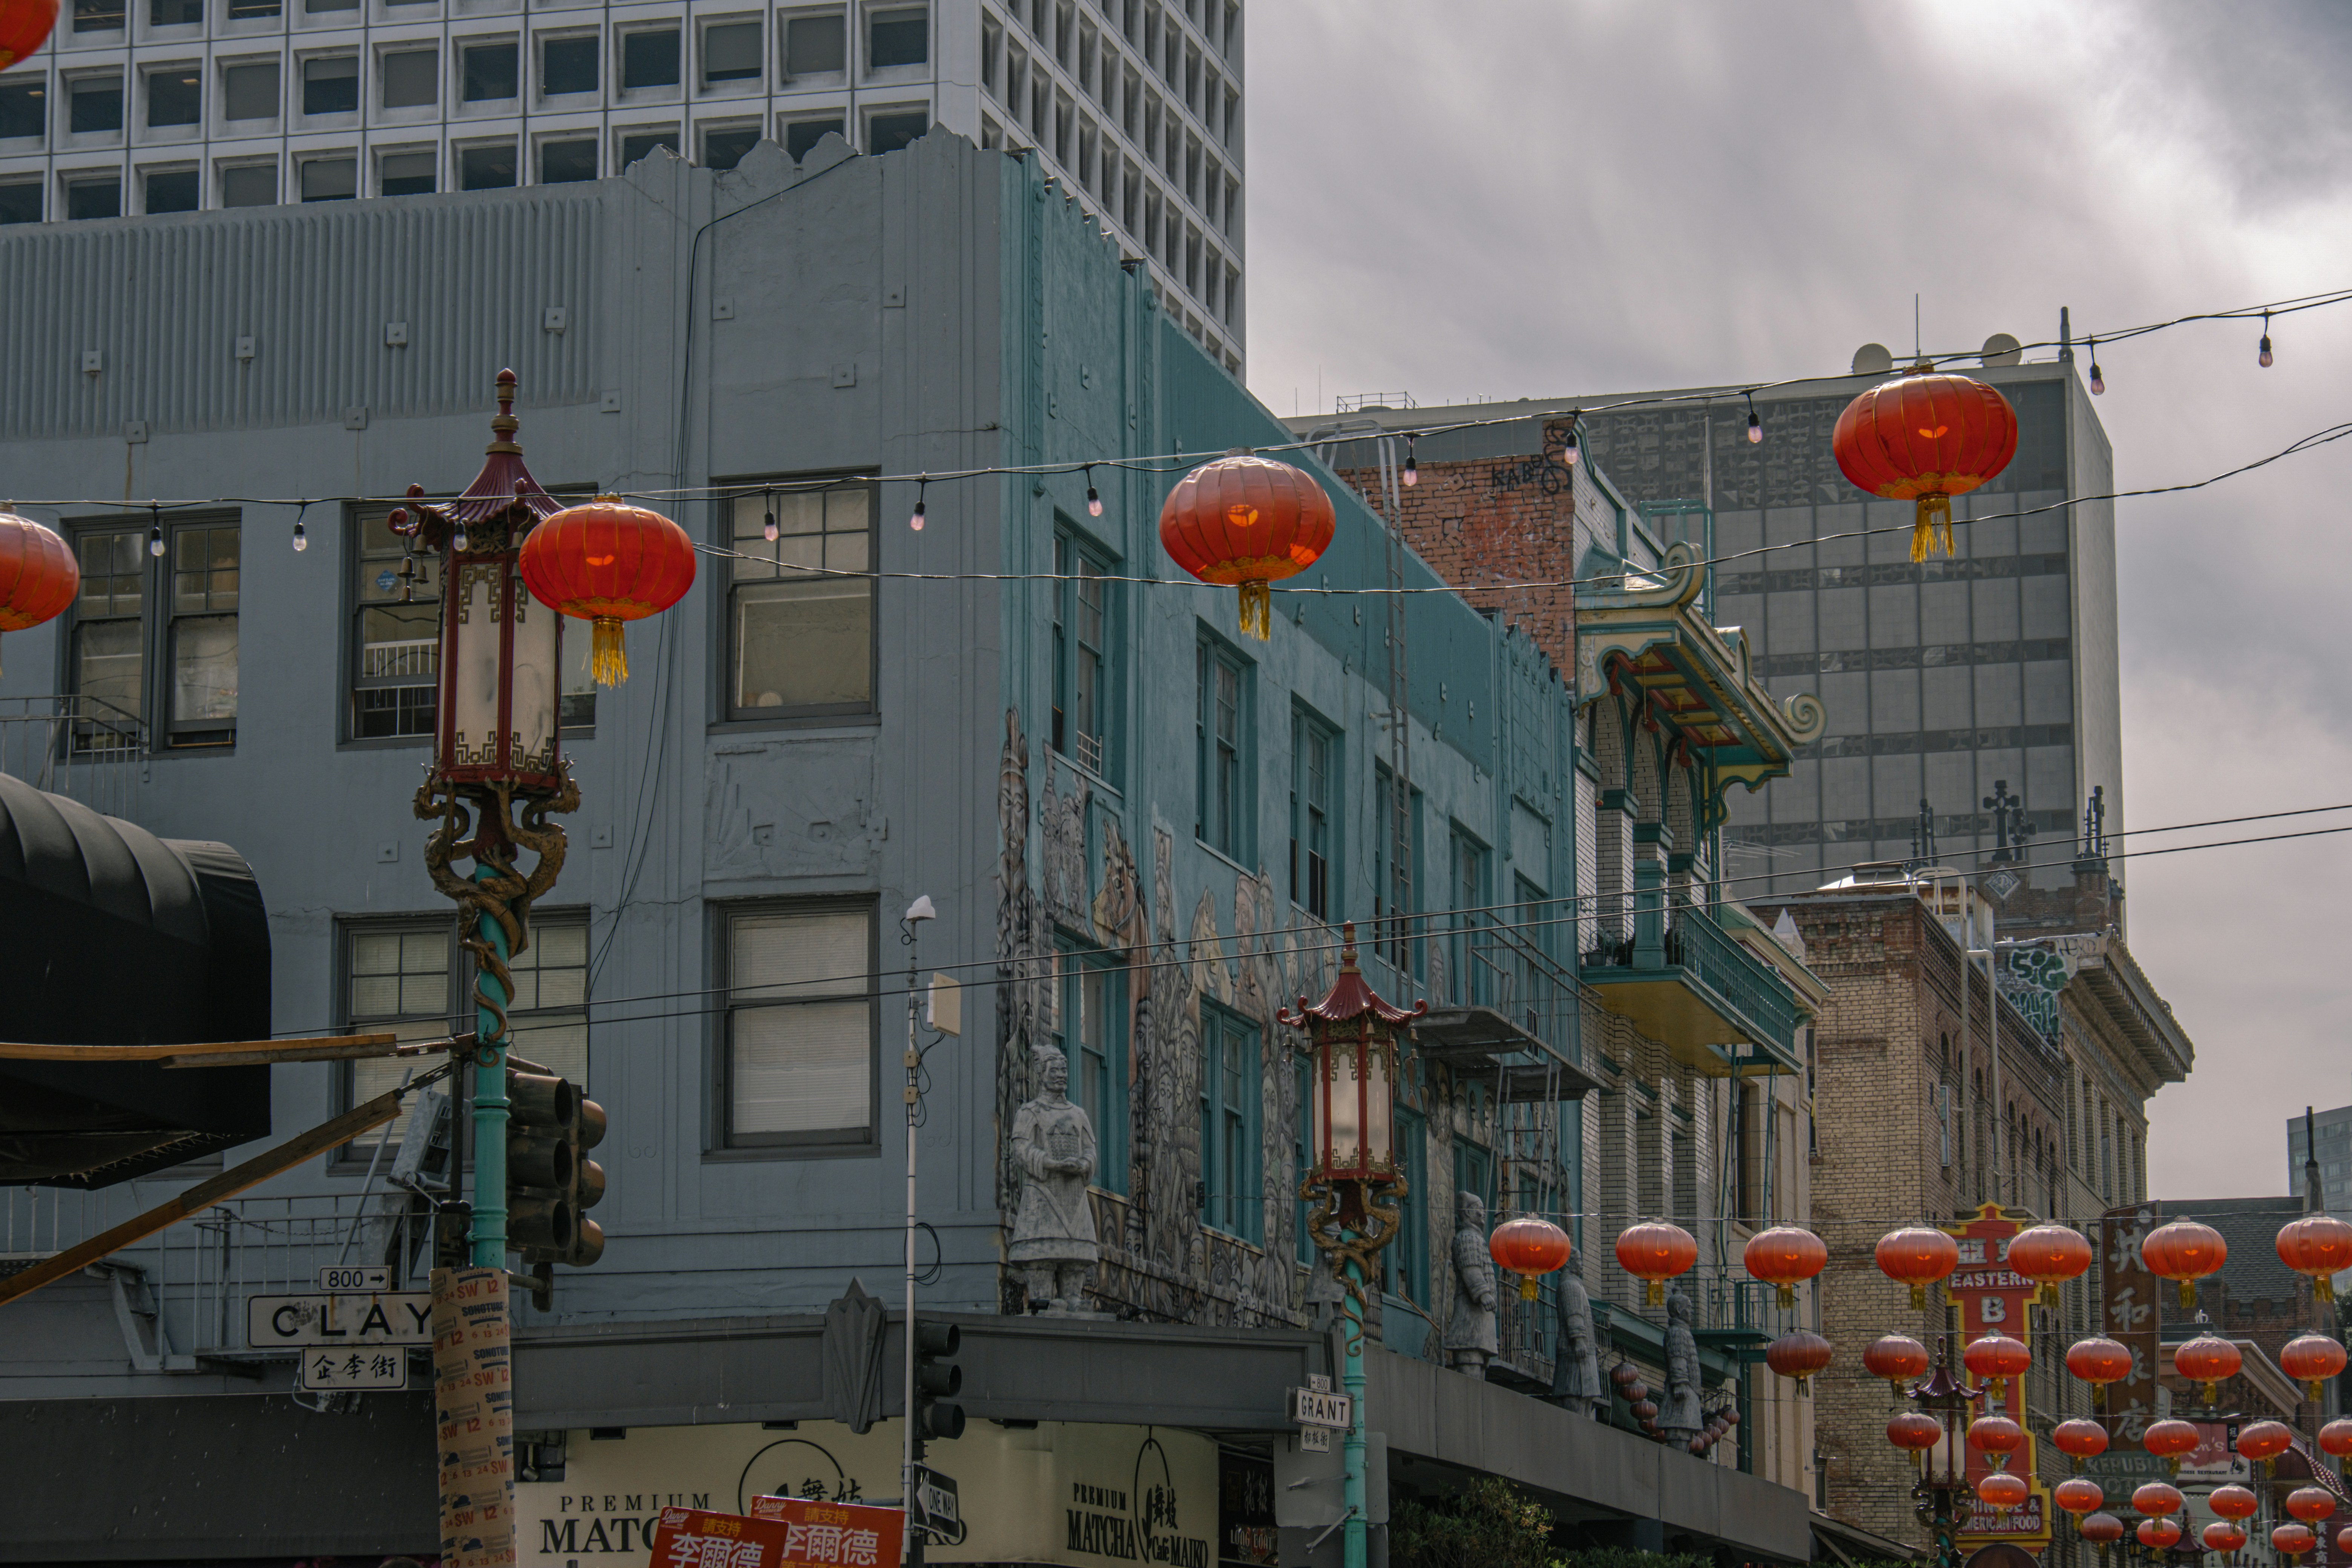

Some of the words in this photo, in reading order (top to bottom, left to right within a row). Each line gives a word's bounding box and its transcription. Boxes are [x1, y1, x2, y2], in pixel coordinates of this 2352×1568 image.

[328, 1271, 363, 1288] 800
[1951, 1272, 2034, 1288] EASTERN
[445, 1292, 455, 1300] 24
[457, 1284, 478, 1299] SW
[487, 1280, 499, 1293] 12
[461, 1302, 504, 1317] SONOTUBE
[272, 1303, 432, 1337] CLAY
[450, 1331, 464, 1346] 12
[312, 1354, 395, 1380] 企李街
[459, 1378, 471, 1387] 24
[474, 1371, 494, 1386] SW
[501, 1369, 508, 1382] 12
[1317, 1378, 1328, 1390] 800
[1302, 1395, 1346, 1421] GRANT
[442, 1423, 457, 1441] SW
[467, 1418, 481, 1433] 12
[1304, 1429, 1328, 1447] 都板街
[477, 1465, 488, 1475] 24
[491, 1460, 507, 1474] SW
[560, 1493, 710, 1512] PREMIUM
[754, 1499, 787, 1512] Danny
[929, 1488, 941, 1513] ONE
[943, 1493, 954, 1518] WAY
[1073, 1482, 1127, 1511] PREMIUM
[2028, 1498, 2040, 1513] &
[445, 1519, 453, 1528] 24
[455, 1510, 474, 1527] SW
[484, 1506, 498, 1521] 12
[662, 1509, 689, 1522] Danny
[804, 1506, 850, 1525] 請支持
[2011, 1514, 2041, 1531] FOOD
[702, 1518, 741, 1537] 請支持
[1067, 1509, 1138, 1560] MATCHA
[1231, 1529, 1250, 1547] LONG
[1254, 1534, 1272, 1550] BOAT
[2315, 1522, 2328, 1568] 廣東商
[494, 1554, 504, 1562] 24
[1152, 1536, 1169, 1562] Café
[1170, 1535, 1208, 1568] MAIKO
